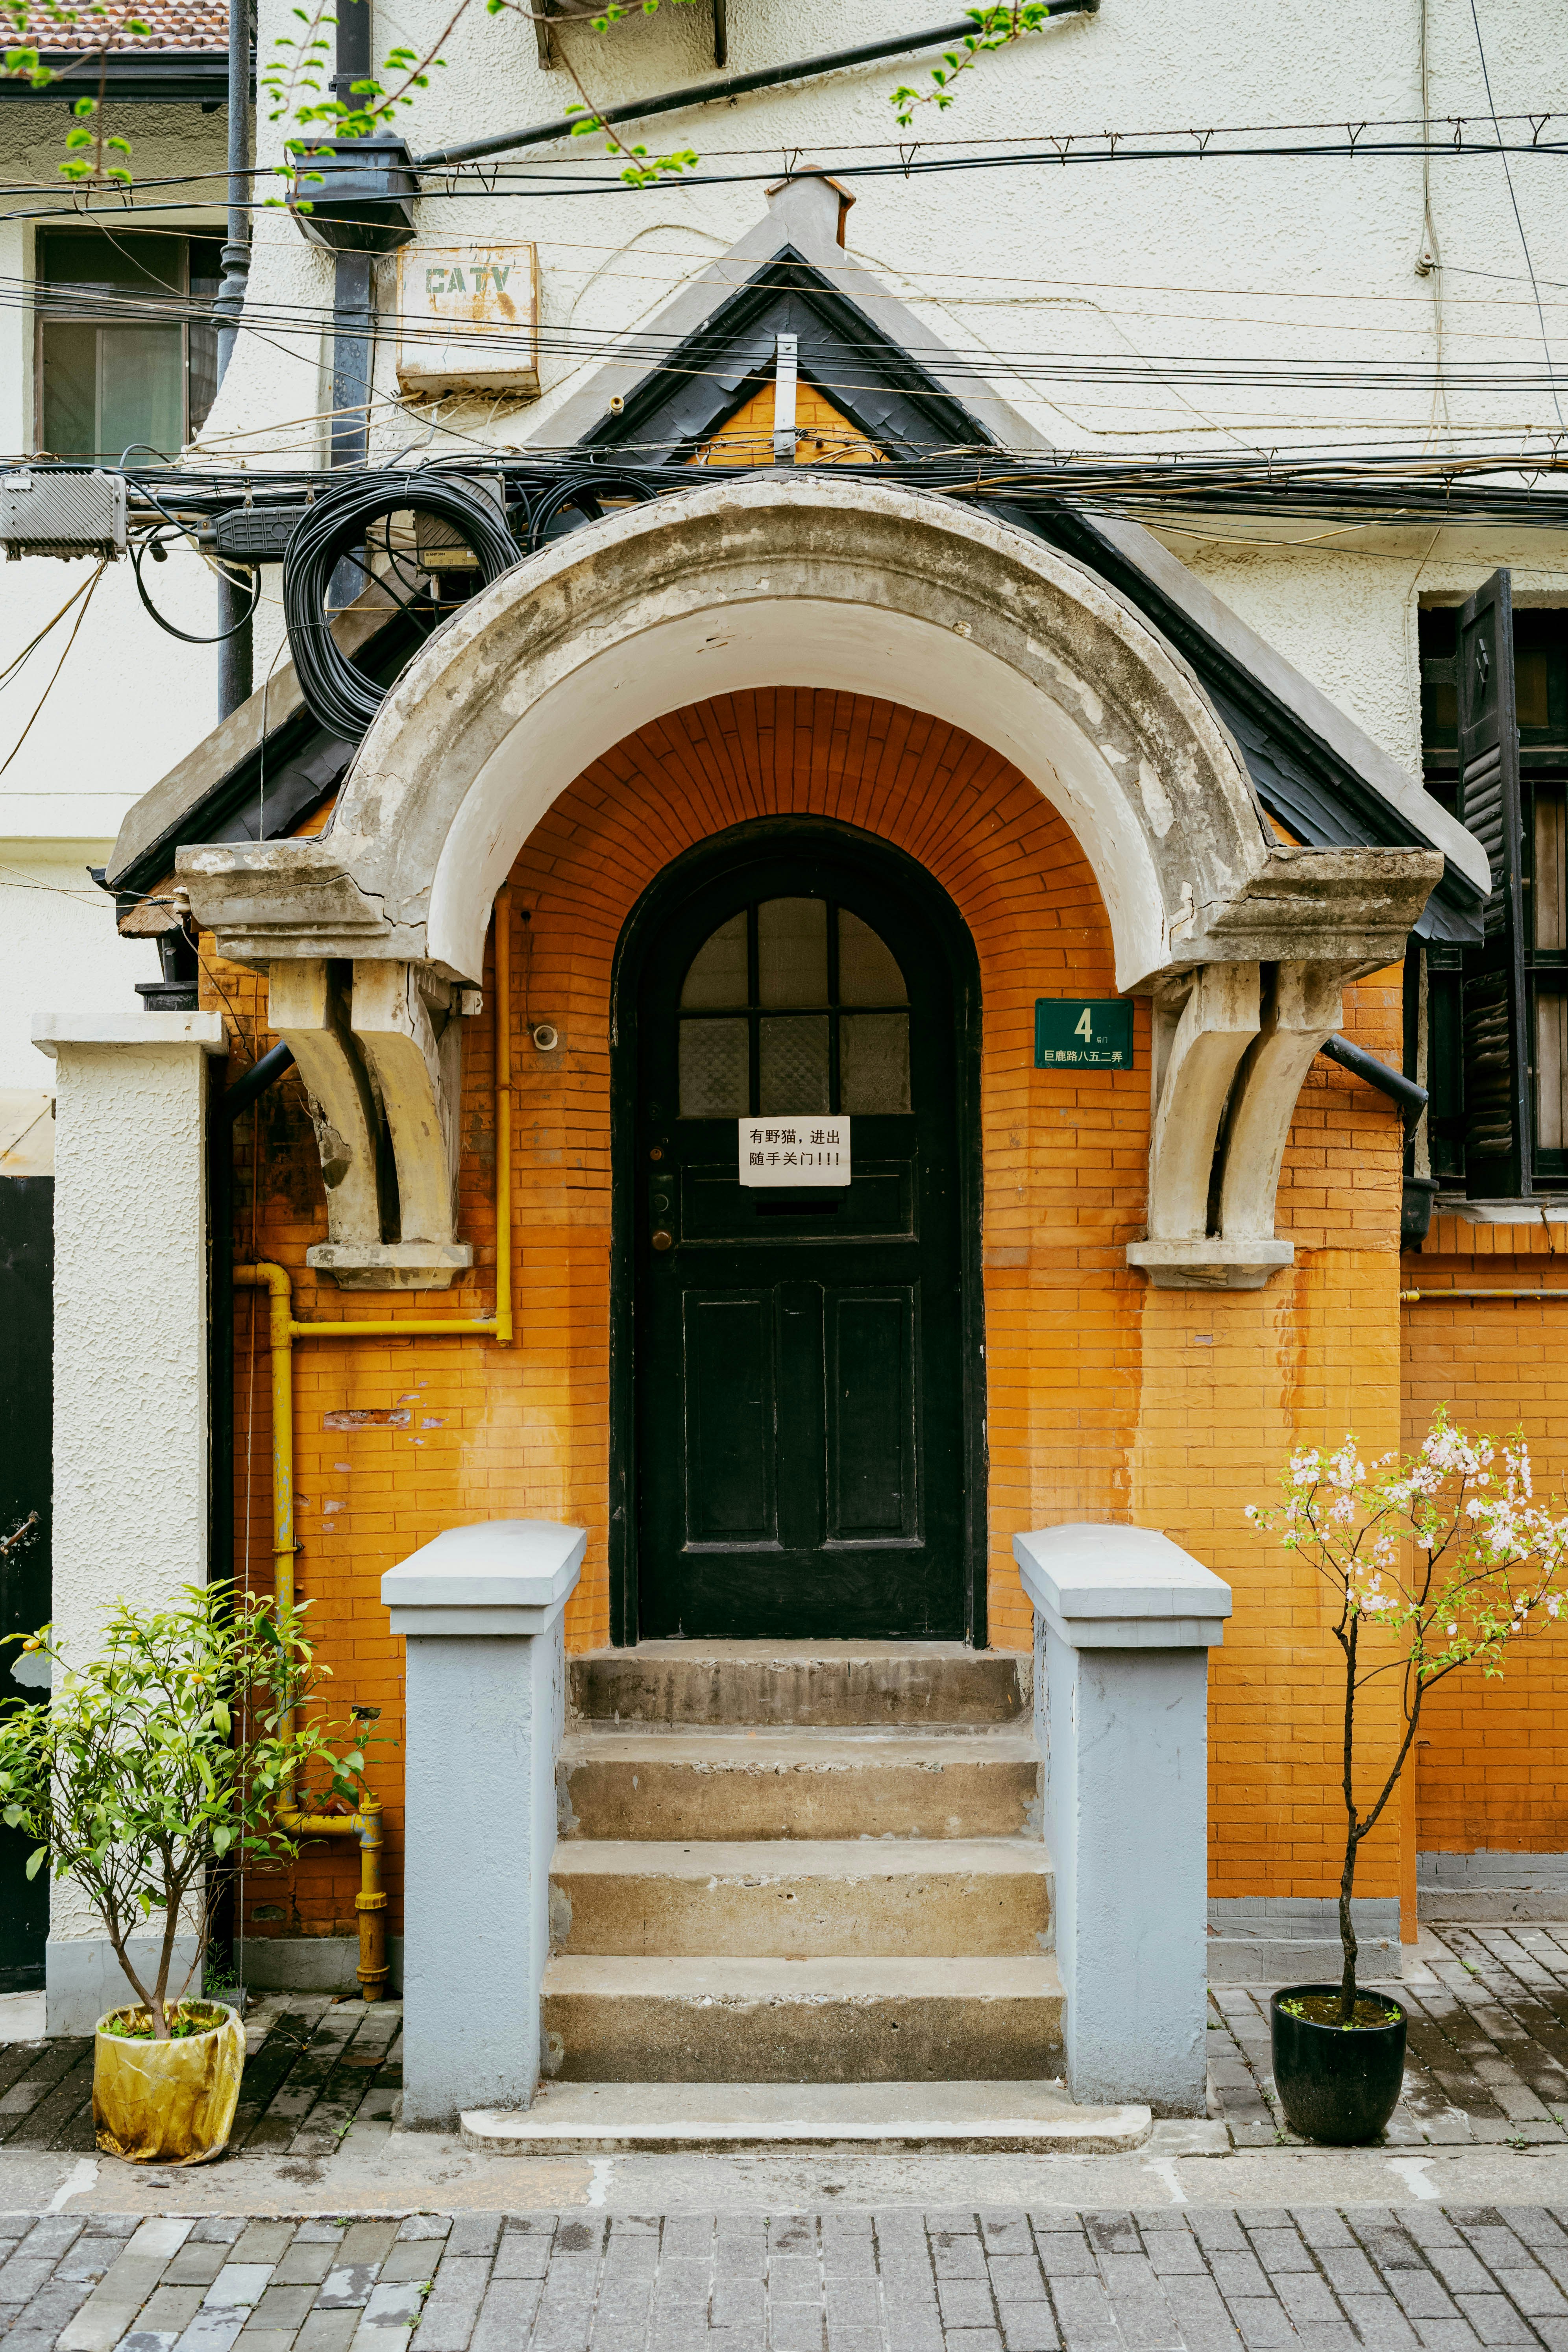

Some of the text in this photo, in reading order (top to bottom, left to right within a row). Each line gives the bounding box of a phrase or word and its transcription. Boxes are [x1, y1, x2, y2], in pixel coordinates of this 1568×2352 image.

[425, 266, 510, 293] CATV
[1074, 1008, 1093, 1043] 4
[1044, 1050, 1123, 1063] 巨鹿路八五二弄
